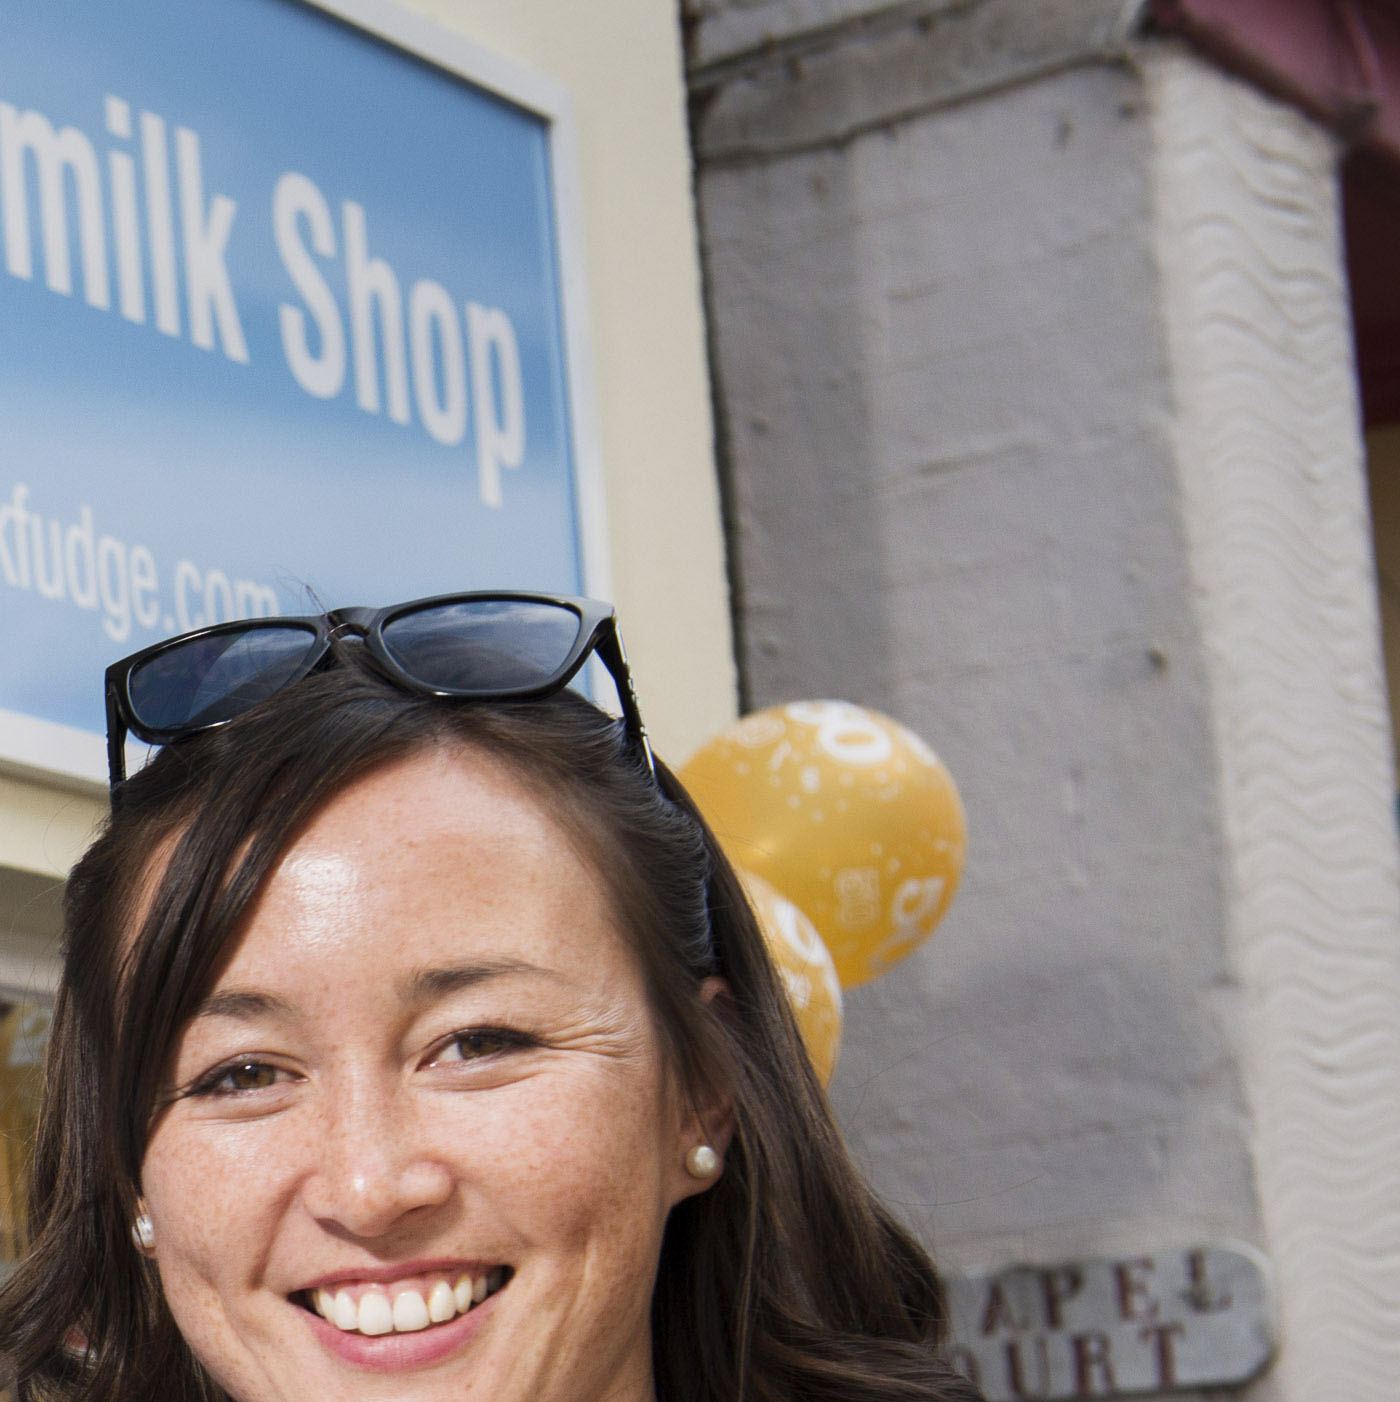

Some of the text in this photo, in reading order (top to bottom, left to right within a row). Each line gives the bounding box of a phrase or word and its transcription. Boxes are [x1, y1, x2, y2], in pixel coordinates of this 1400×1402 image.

[273, 172, 527, 508] Shop
[979, 1250, 1235, 1340] APEL
[956, 1321, 1186, 1398] URT
